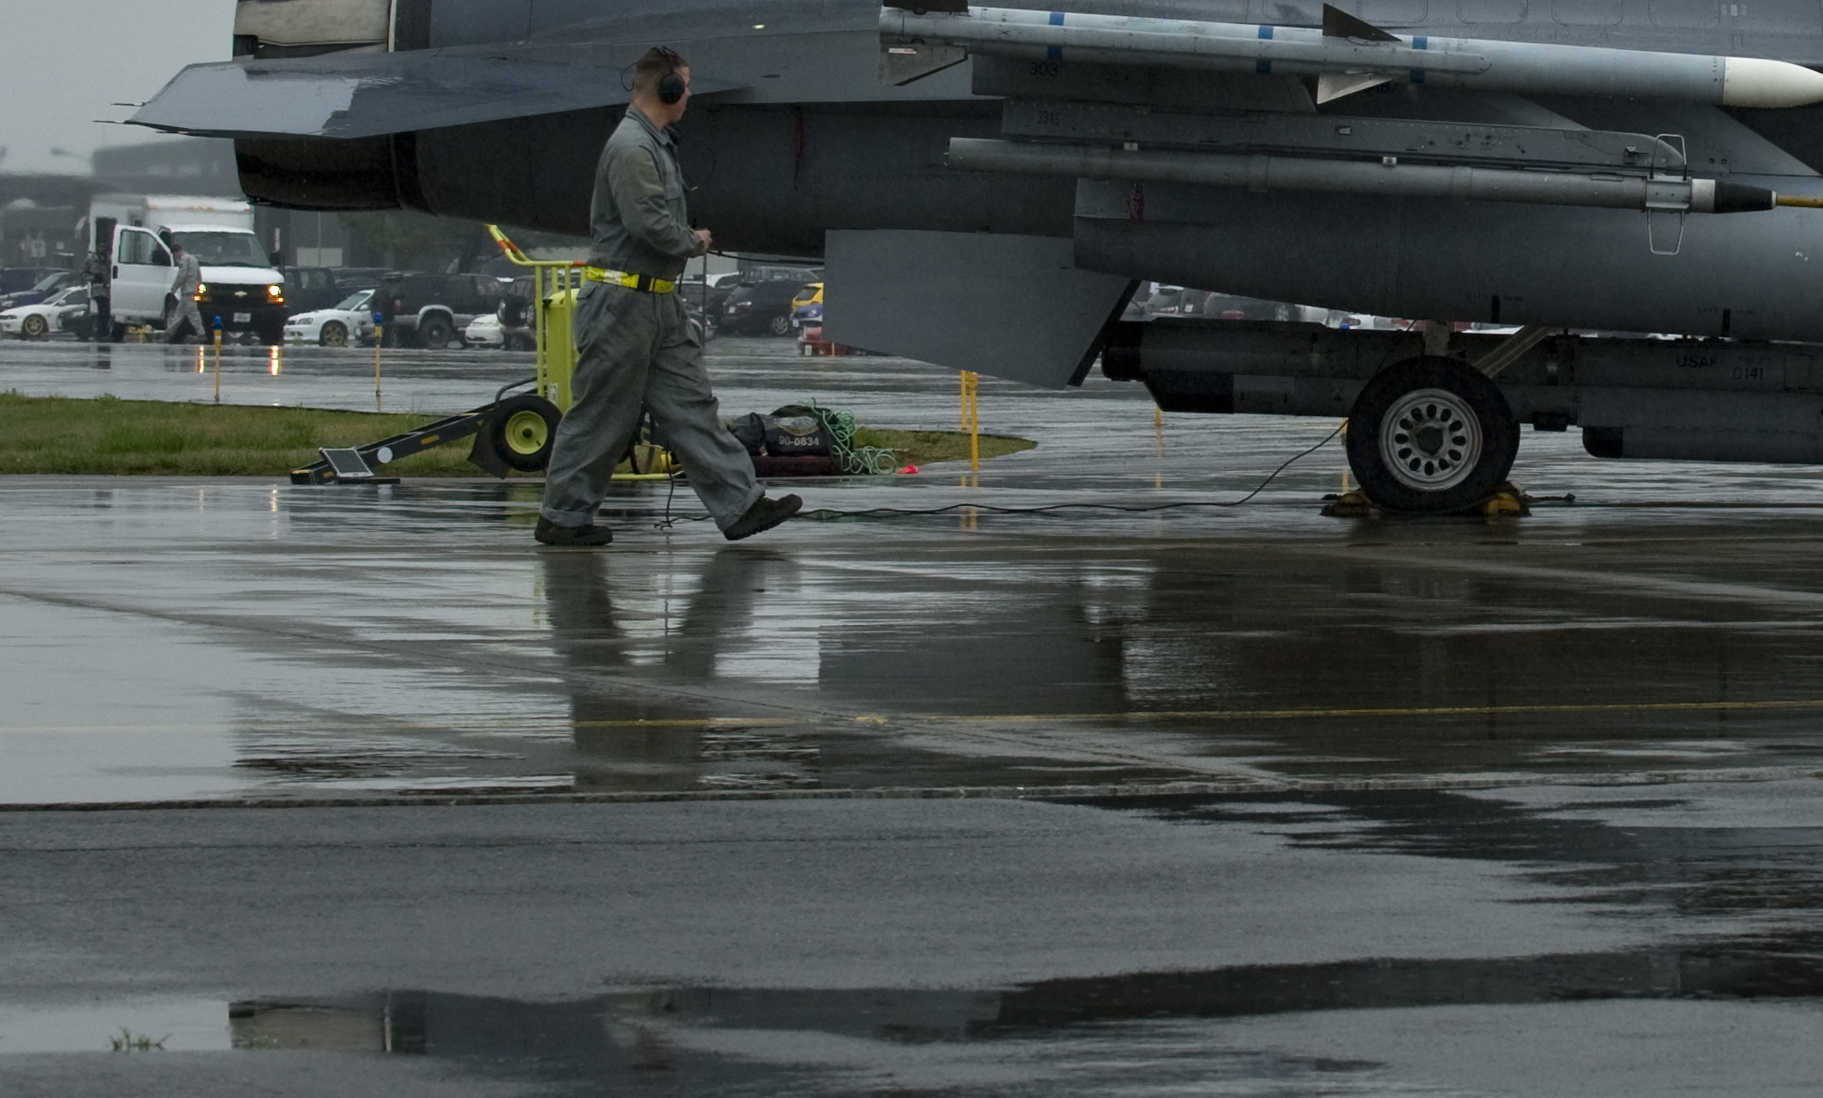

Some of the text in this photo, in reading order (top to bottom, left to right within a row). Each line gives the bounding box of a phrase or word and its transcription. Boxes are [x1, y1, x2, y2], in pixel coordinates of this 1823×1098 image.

[1028, 62, 1060, 77] 303
[1676, 355, 1718, 369] USAF
[1733, 367, 1764, 381] 0141
[779, 436, 820, 446] 90-0834
